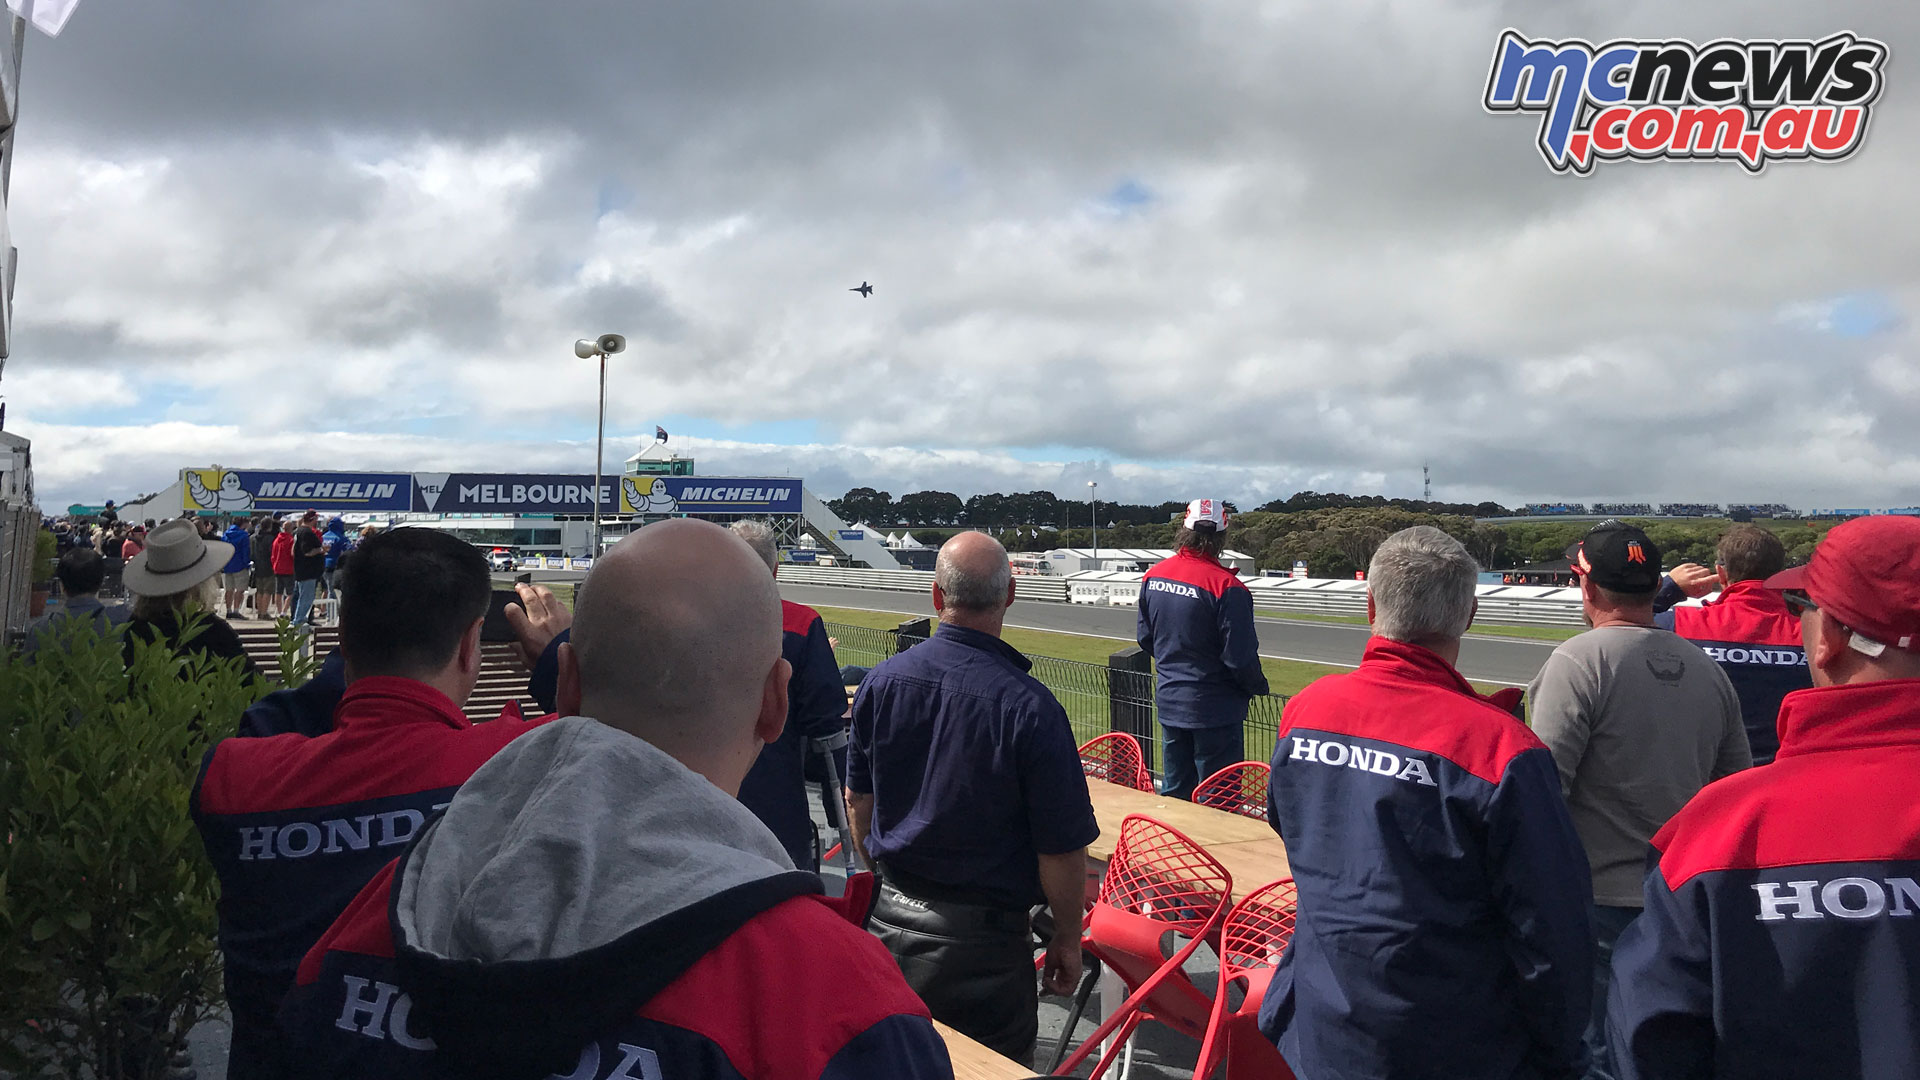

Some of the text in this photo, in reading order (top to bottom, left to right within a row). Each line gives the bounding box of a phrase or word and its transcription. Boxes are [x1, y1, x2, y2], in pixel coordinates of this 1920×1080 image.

[258, 481, 397, 498] MICHELIN
[420, 485, 441, 494] MEL
[459, 483, 611, 504] MELBOURNE
[680, 487, 791, 501] MICHELIN
[1148, 580, 1200, 599] HONDA
[1289, 737, 1438, 787] HONDA
[239, 803, 452, 861] HOND
